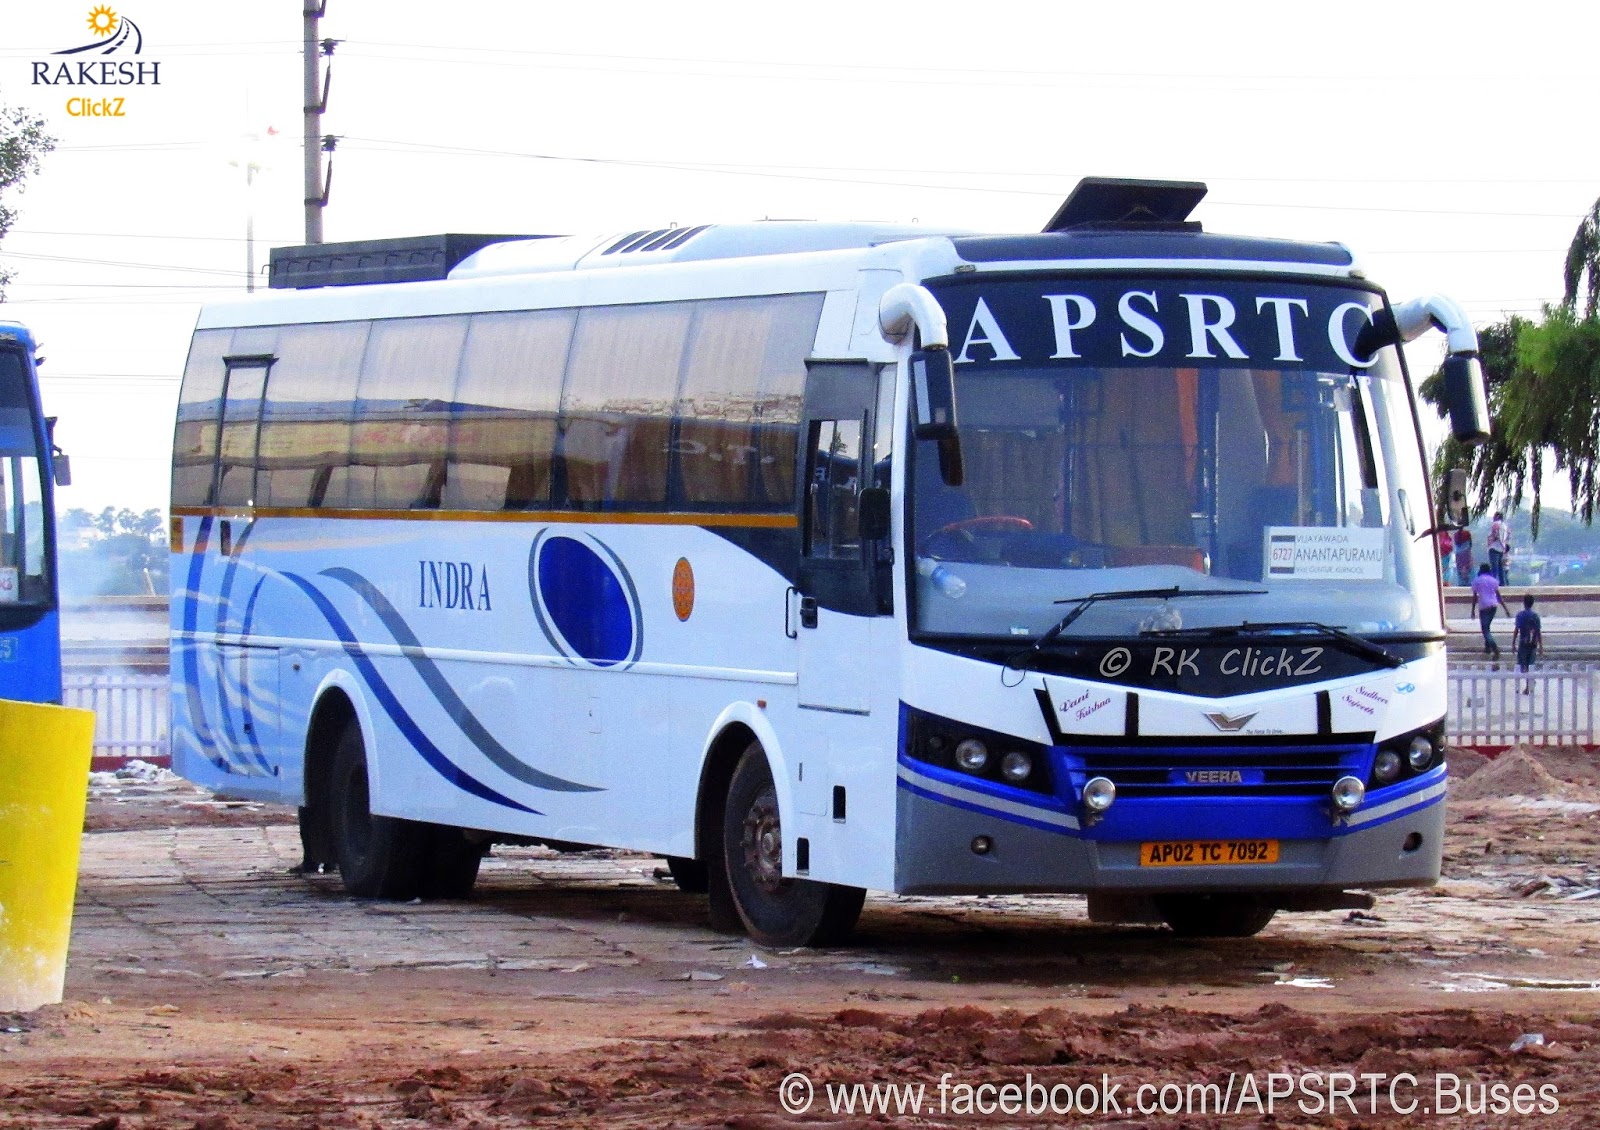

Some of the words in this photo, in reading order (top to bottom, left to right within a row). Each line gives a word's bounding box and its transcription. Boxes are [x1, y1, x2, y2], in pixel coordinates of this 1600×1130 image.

[1273, 548, 1293, 561] 6727
[1295, 547, 1383, 562] ANANTAPURAMU
[419, 560, 492, 611] INDRA
[1185, 770, 1243, 783] VEERA
[1150, 843, 1193, 863] AP02
[1201, 843, 1222, 861] TC
[1228, 842, 1268, 860] 7092
